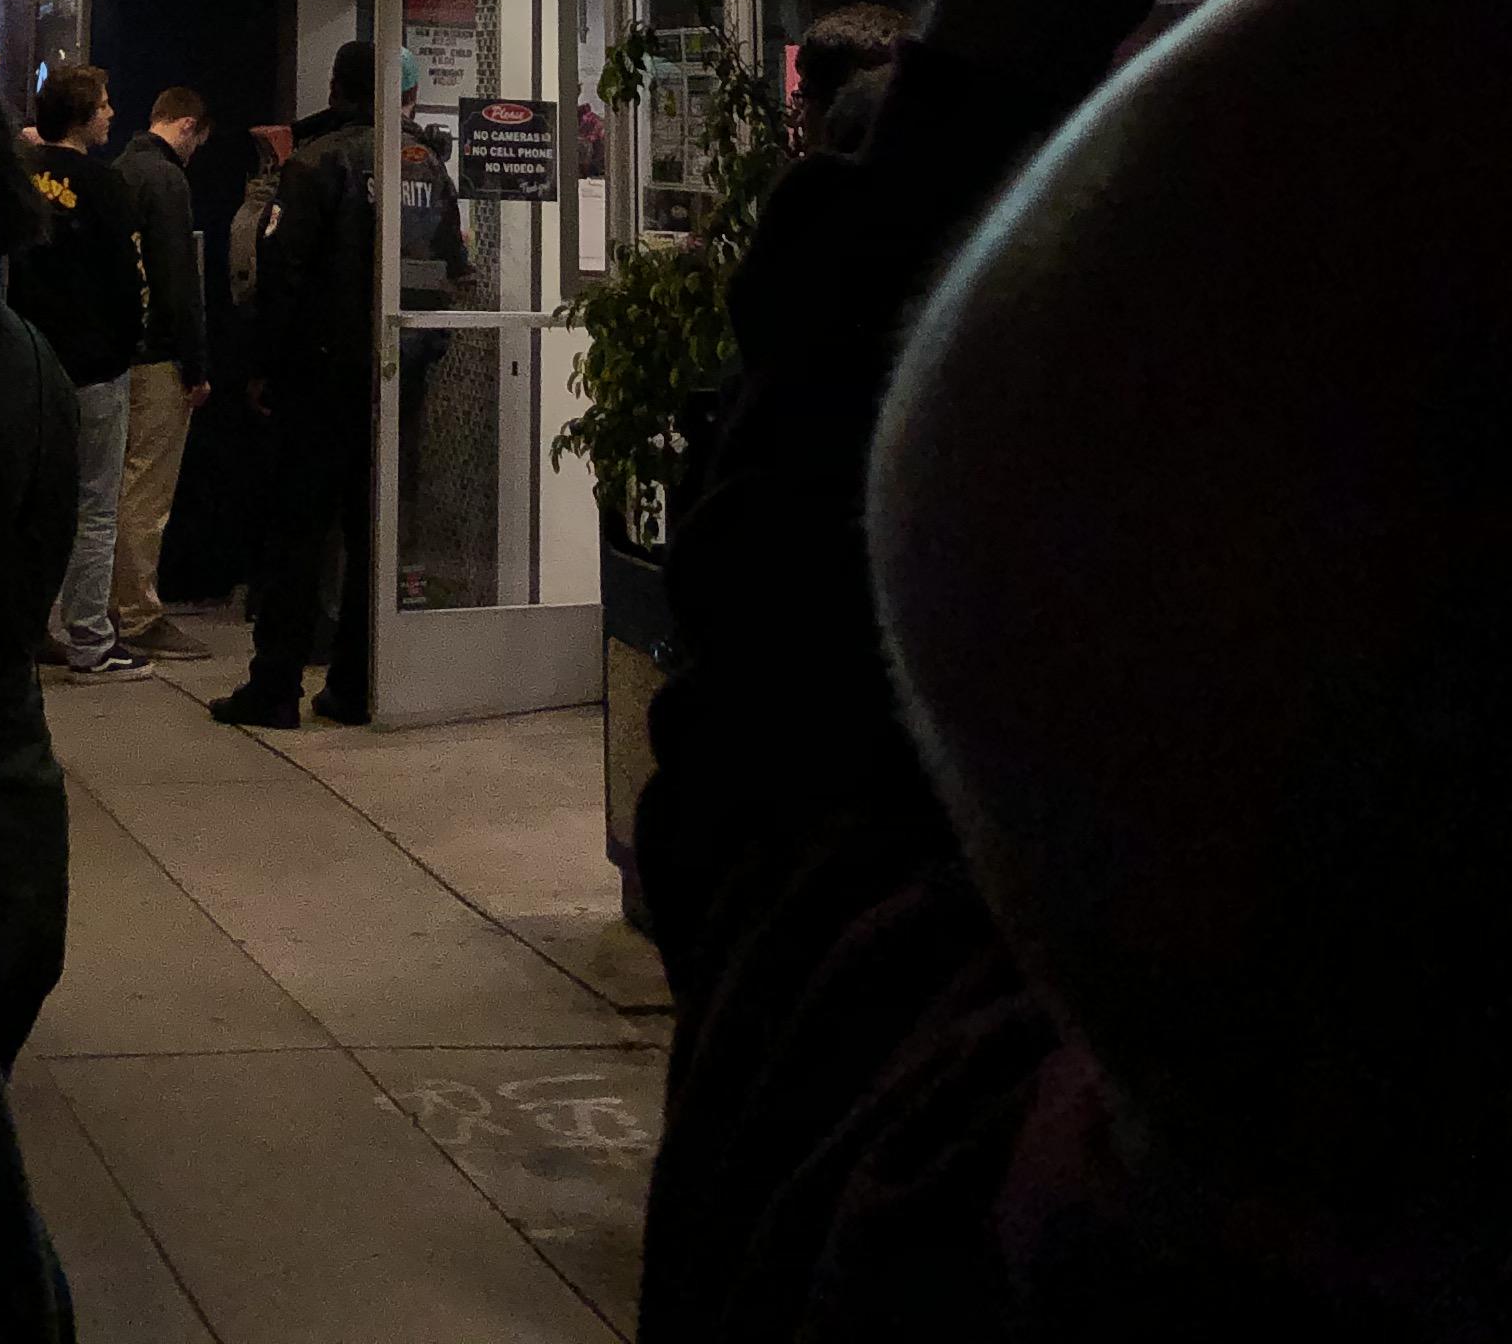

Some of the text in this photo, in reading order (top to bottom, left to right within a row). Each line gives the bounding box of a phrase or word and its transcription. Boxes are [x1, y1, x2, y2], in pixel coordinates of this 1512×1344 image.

[473, 130, 540, 142] NO CAMERAS
[472, 146, 553, 159] NO CELL PHONE
[485, 162, 534, 174] NO VIDEO
